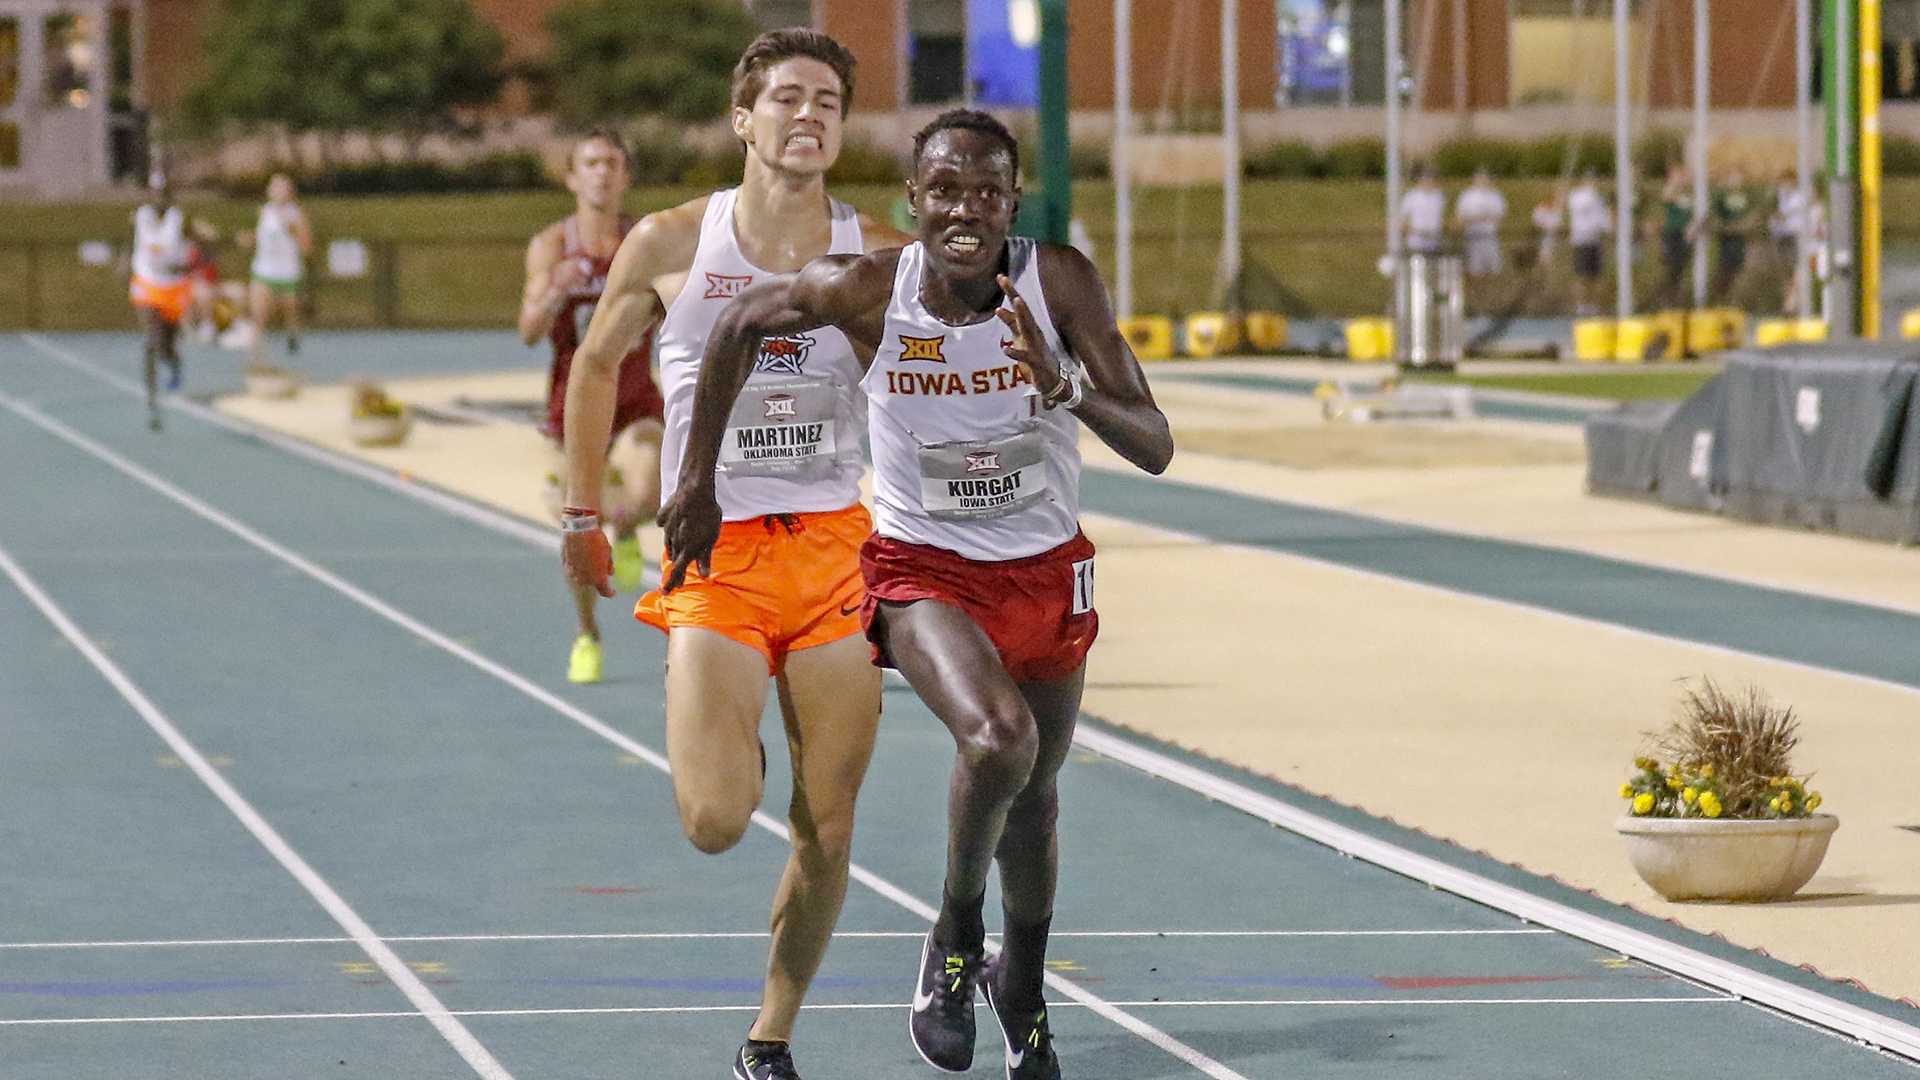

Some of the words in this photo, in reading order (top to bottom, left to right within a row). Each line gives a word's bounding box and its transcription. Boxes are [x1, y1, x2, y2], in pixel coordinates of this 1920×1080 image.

[898, 334, 947, 363] XII
[886, 370, 967, 396] IOWA
[971, 363, 1034, 395] STA
[736, 423, 823, 448] MARTINEZ
[743, 446, 794, 460] OKLAHOMA
[795, 444, 818, 457] STATE
[947, 470, 1022, 497] KURGAT
[959, 497, 987, 508] IOWA
[988, 492, 1016, 507] STATE
